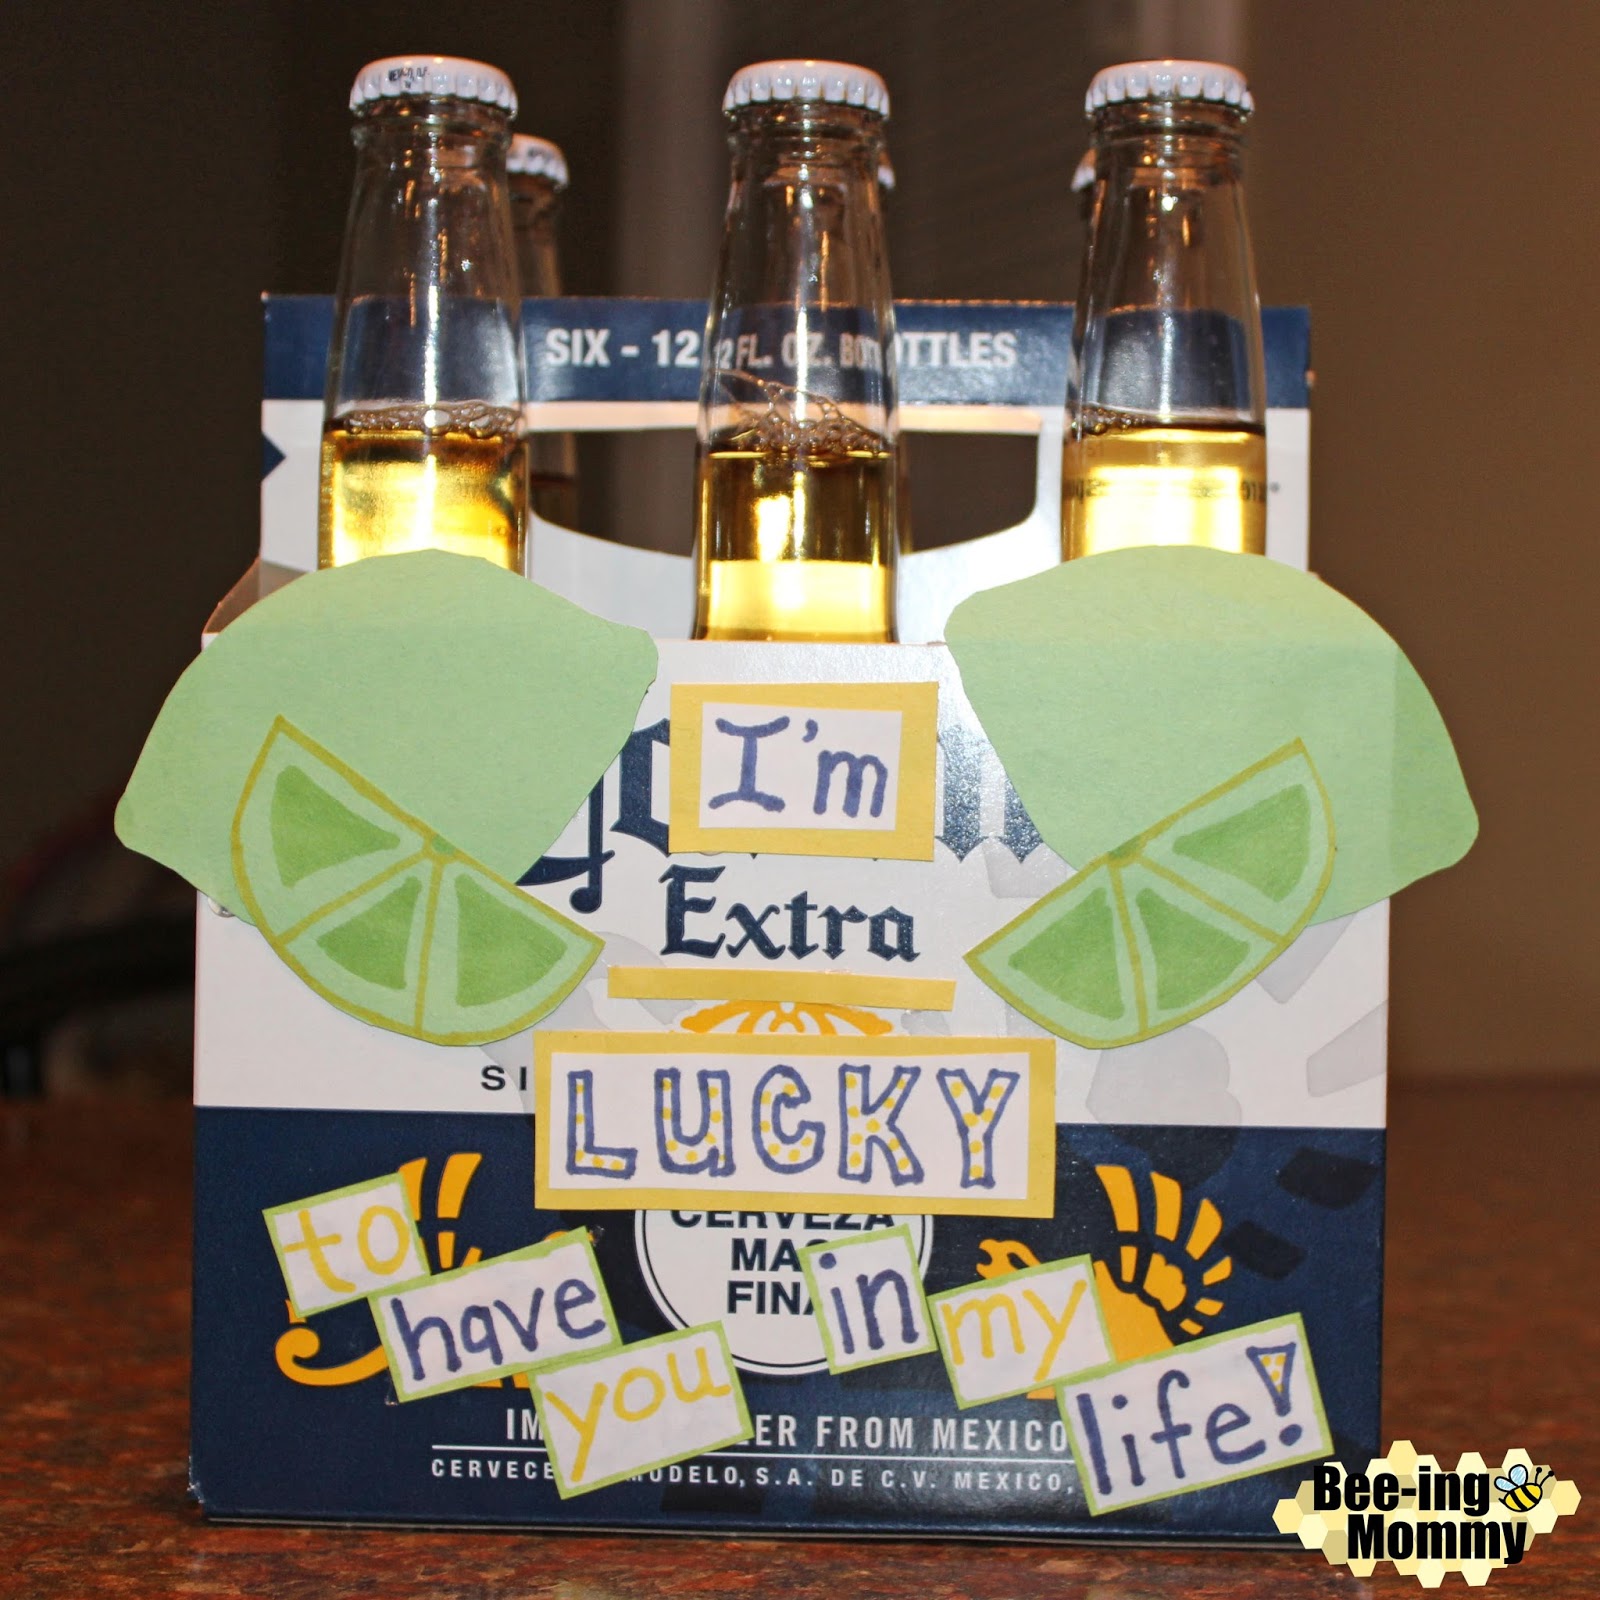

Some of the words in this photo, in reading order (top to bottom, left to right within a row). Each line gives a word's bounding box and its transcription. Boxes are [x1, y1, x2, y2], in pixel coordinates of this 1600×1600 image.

[545, 328, 611, 368] SIX
[652, 330, 699, 368] 12
[781, 331, 832, 368] OZ.
[709, 715, 888, 819] I'm
[659, 863, 920, 962] Extra
[566, 1063, 1020, 1189] LUCKY
[284, 1204, 410, 1293] to
[731, 1238, 829, 1272] MA
[390, 1278, 607, 1382] have
[818, 1252, 919, 1355] in
[940, 1279, 1087, 1382] my
[544, 1345, 733, 1484] you
[738, 1414, 798, 1447] ER
[816, 1415, 914, 1449] FROM
[932, 1418, 1068, 1452] MEXICO
[1075, 1341, 1304, 1496] life!
[431, 1458, 554, 1480] CERVECE
[626, 1464, 746, 1488] ODELO,
[756, 1467, 814, 1487] S.A.
[831, 1469, 863, 1487] DE
[881, 1470, 936, 1489] C.V.
[954, 1471, 1074, 1495] MEXICO,
